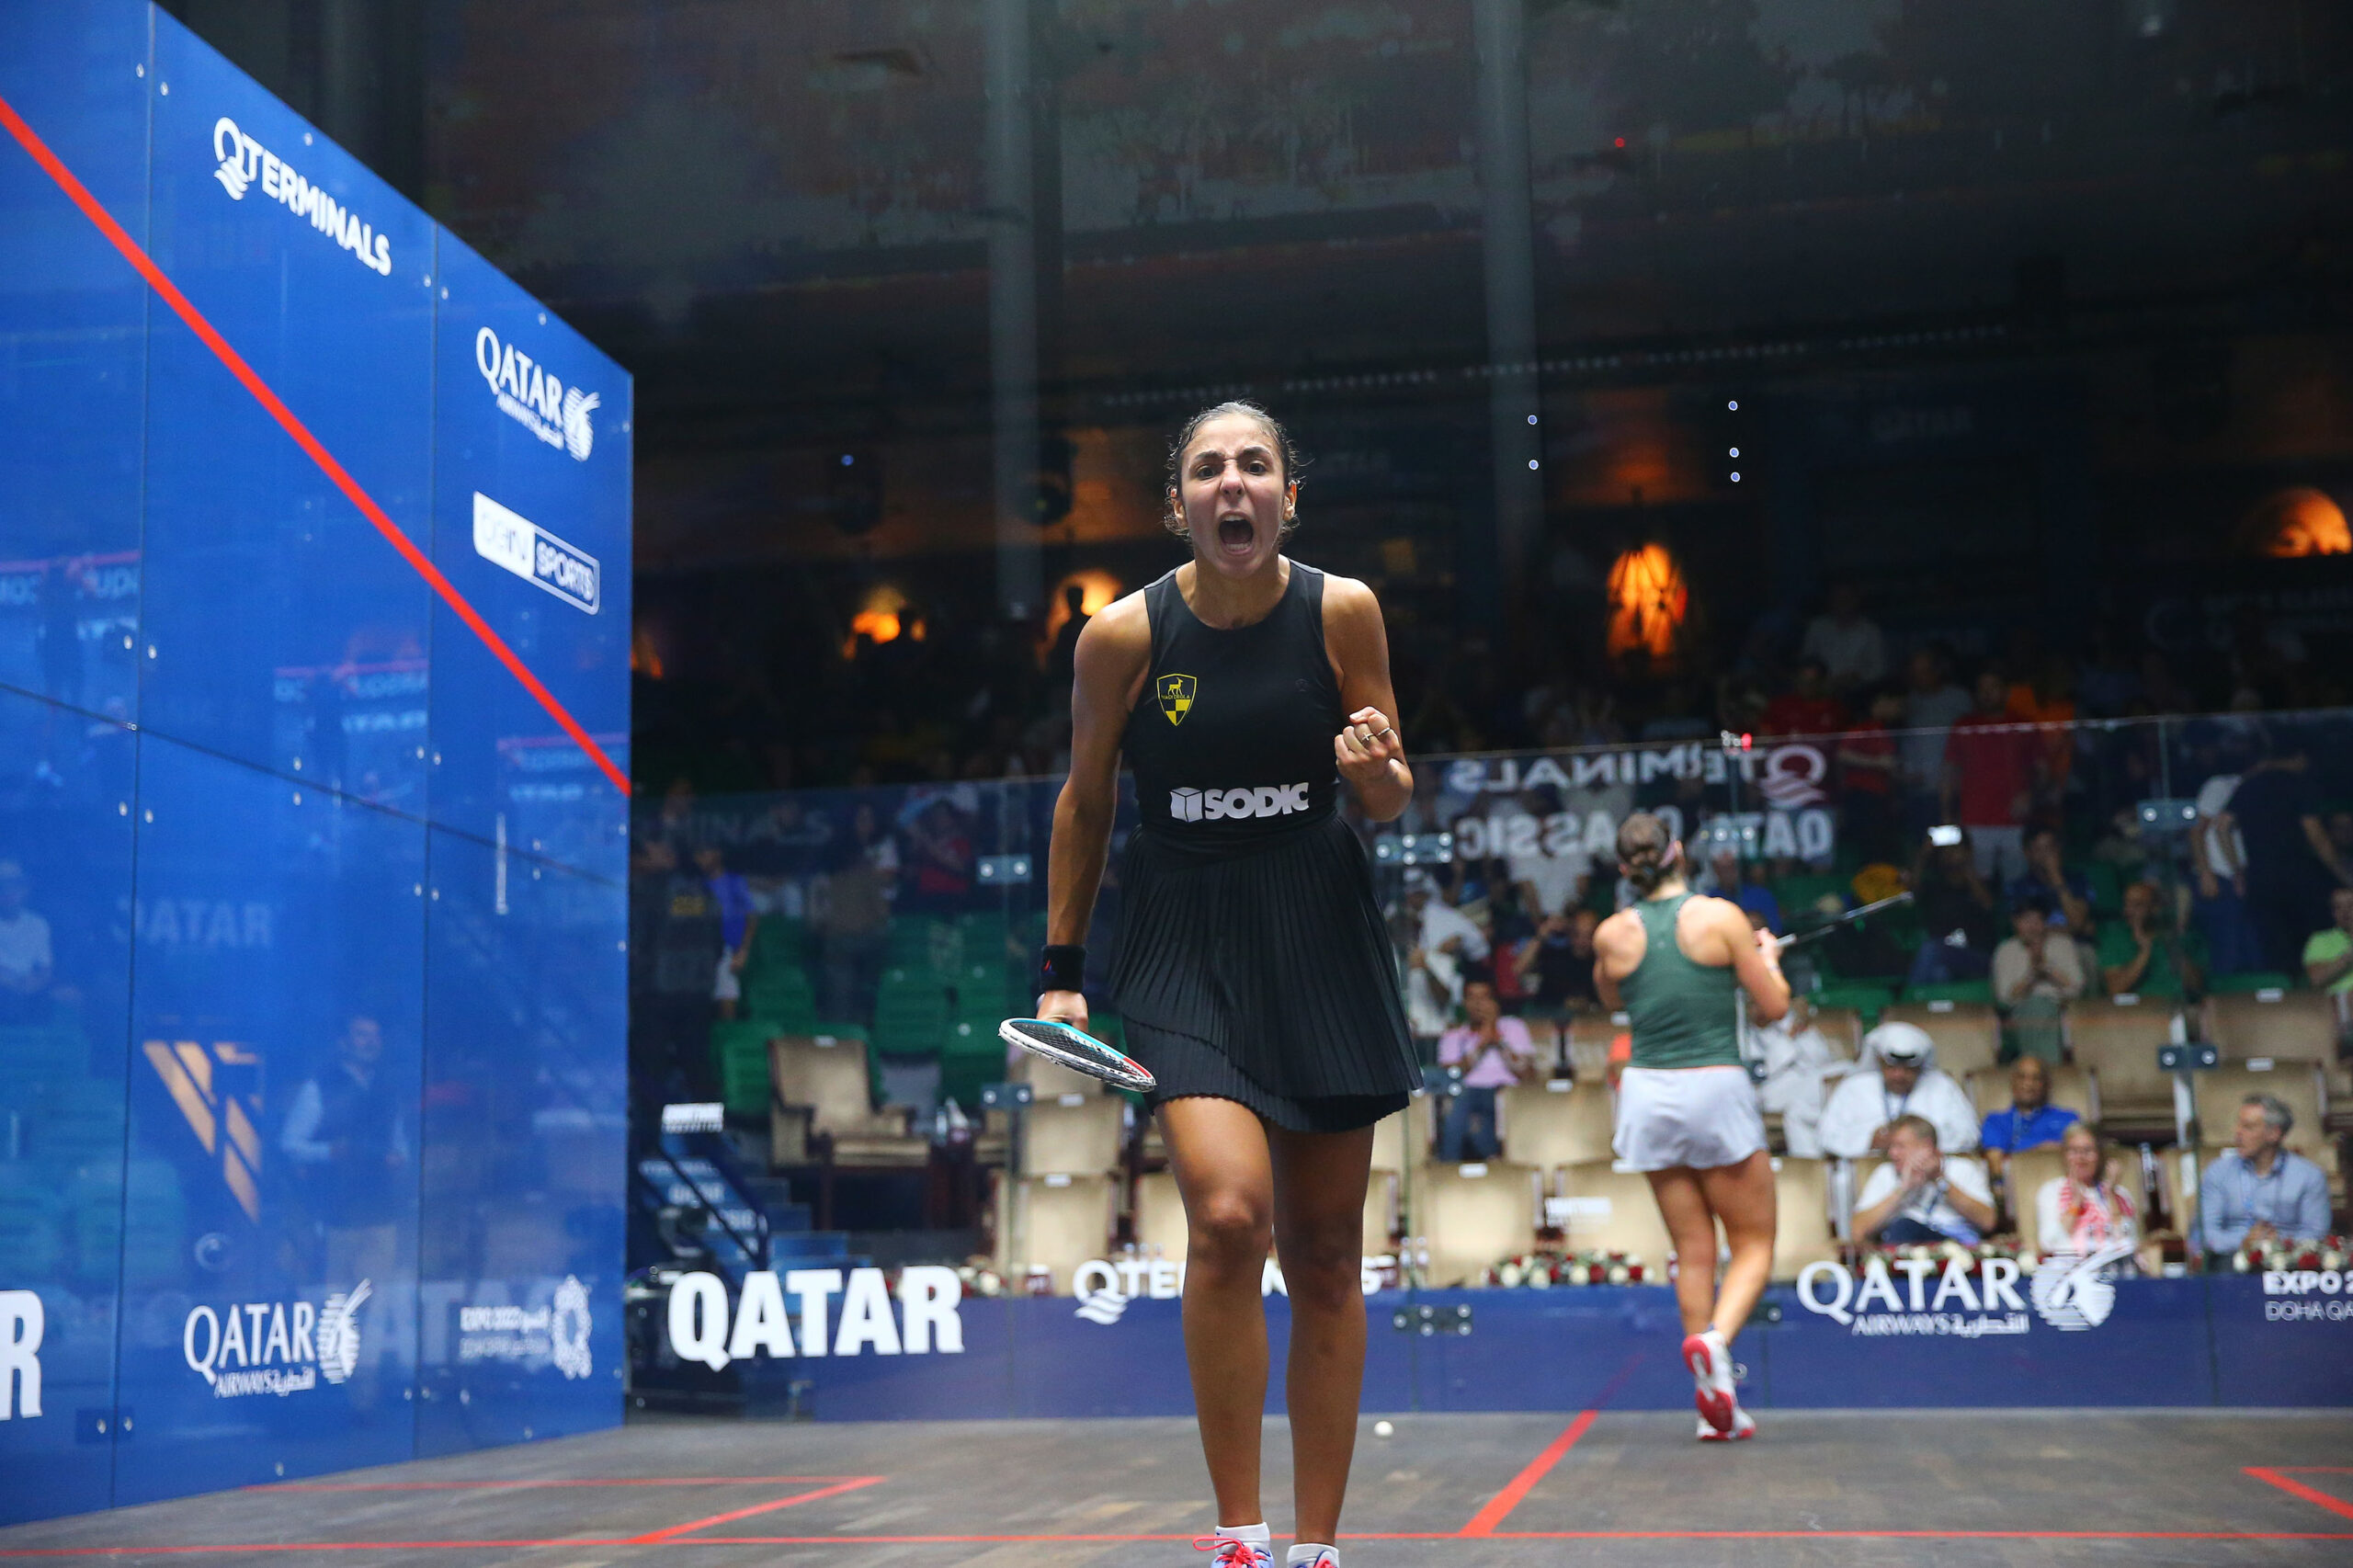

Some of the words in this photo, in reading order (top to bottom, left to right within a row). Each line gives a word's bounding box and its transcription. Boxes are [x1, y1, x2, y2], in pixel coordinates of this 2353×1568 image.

[213, 117, 392, 276] QTERMINALS
[476, 326, 563, 429] QATAR
[1204, 782, 1309, 820] SODIC
[668, 1266, 964, 1371] QATAR
[1796, 1257, 2027, 1325] QATAR
[2262, 1270, 2343, 1295] EXPO
[184, 1301, 315, 1386] QATAR
[1851, 1312, 1951, 1336] AIRWAYS
